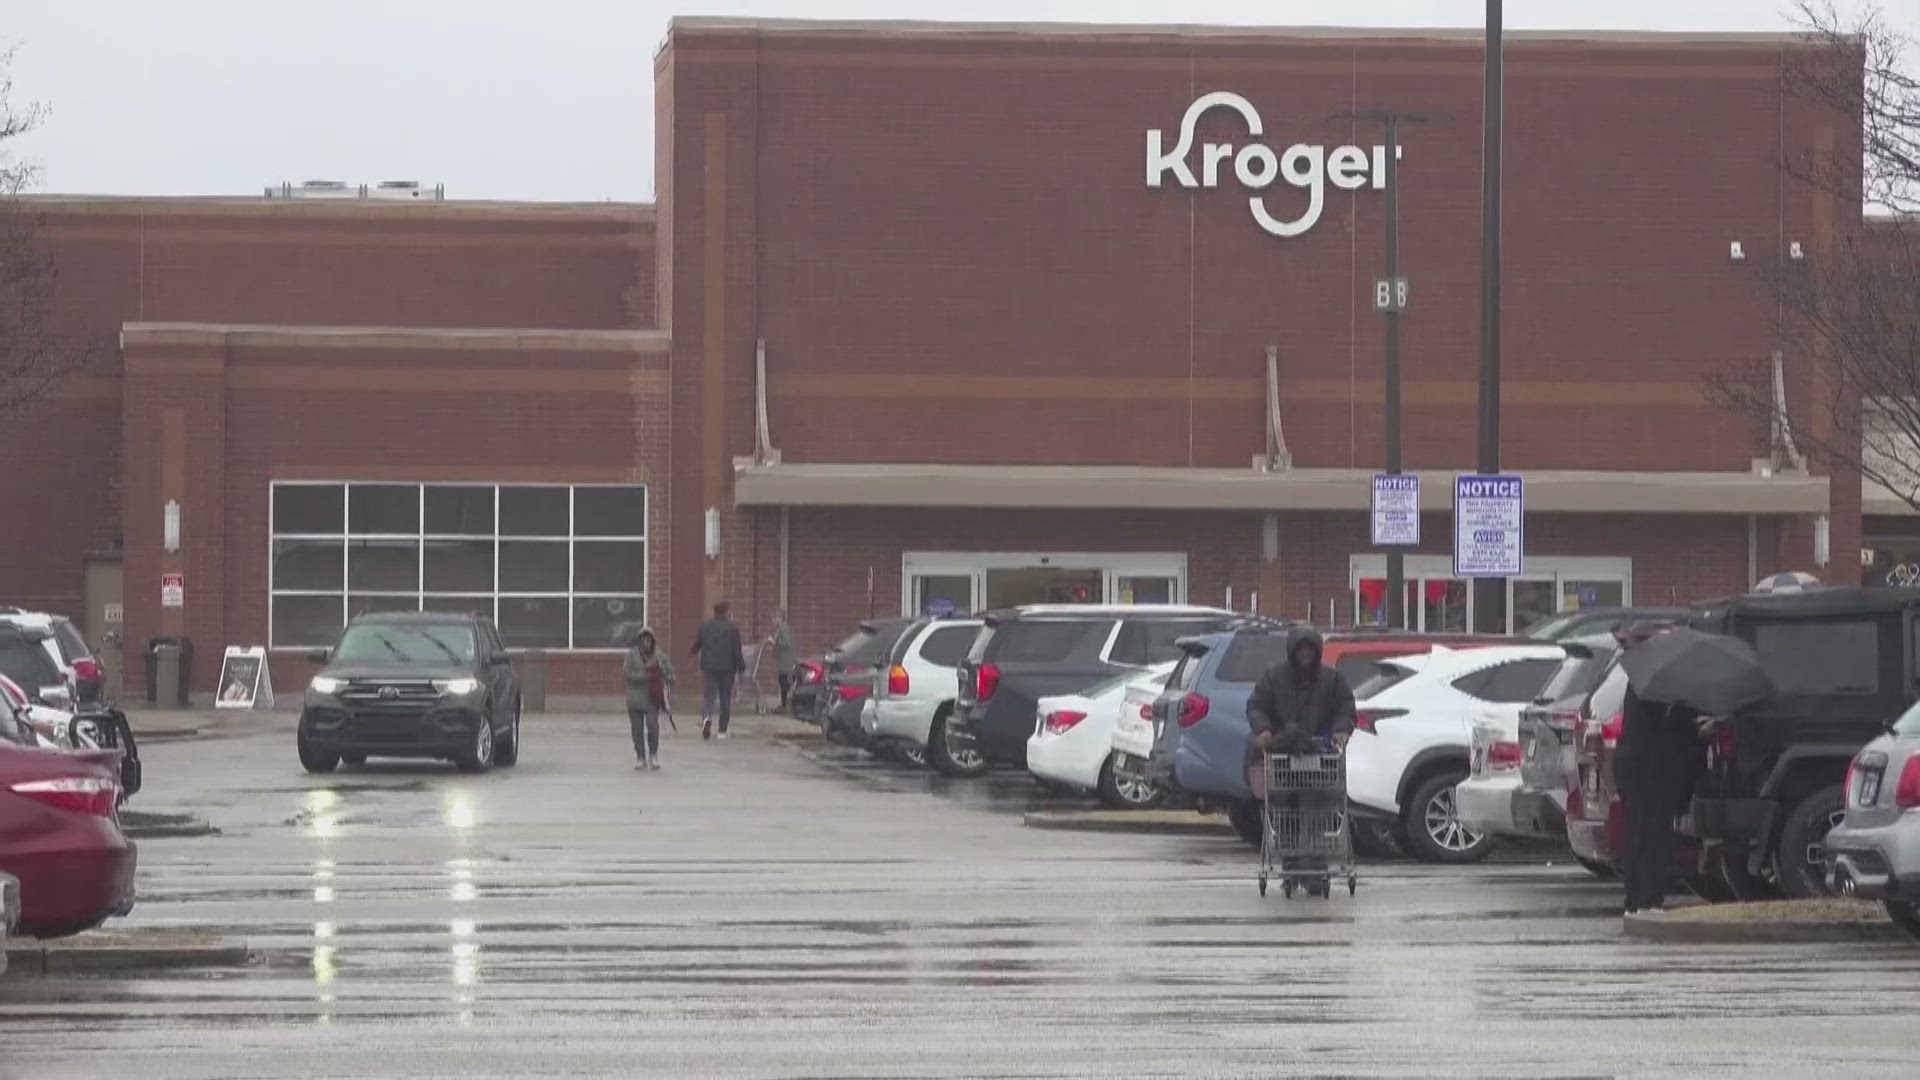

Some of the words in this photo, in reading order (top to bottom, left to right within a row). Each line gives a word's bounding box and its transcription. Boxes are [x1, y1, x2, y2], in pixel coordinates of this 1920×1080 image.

[1146, 91, 1402, 237] Kroger
[1377, 281, 1390, 307] B
[1397, 281, 1407, 307] B
[1375, 478, 1416, 489] NOTICE
[1460, 482, 1520, 496] NOTICE
[1475, 532, 1504, 542] AVISO
